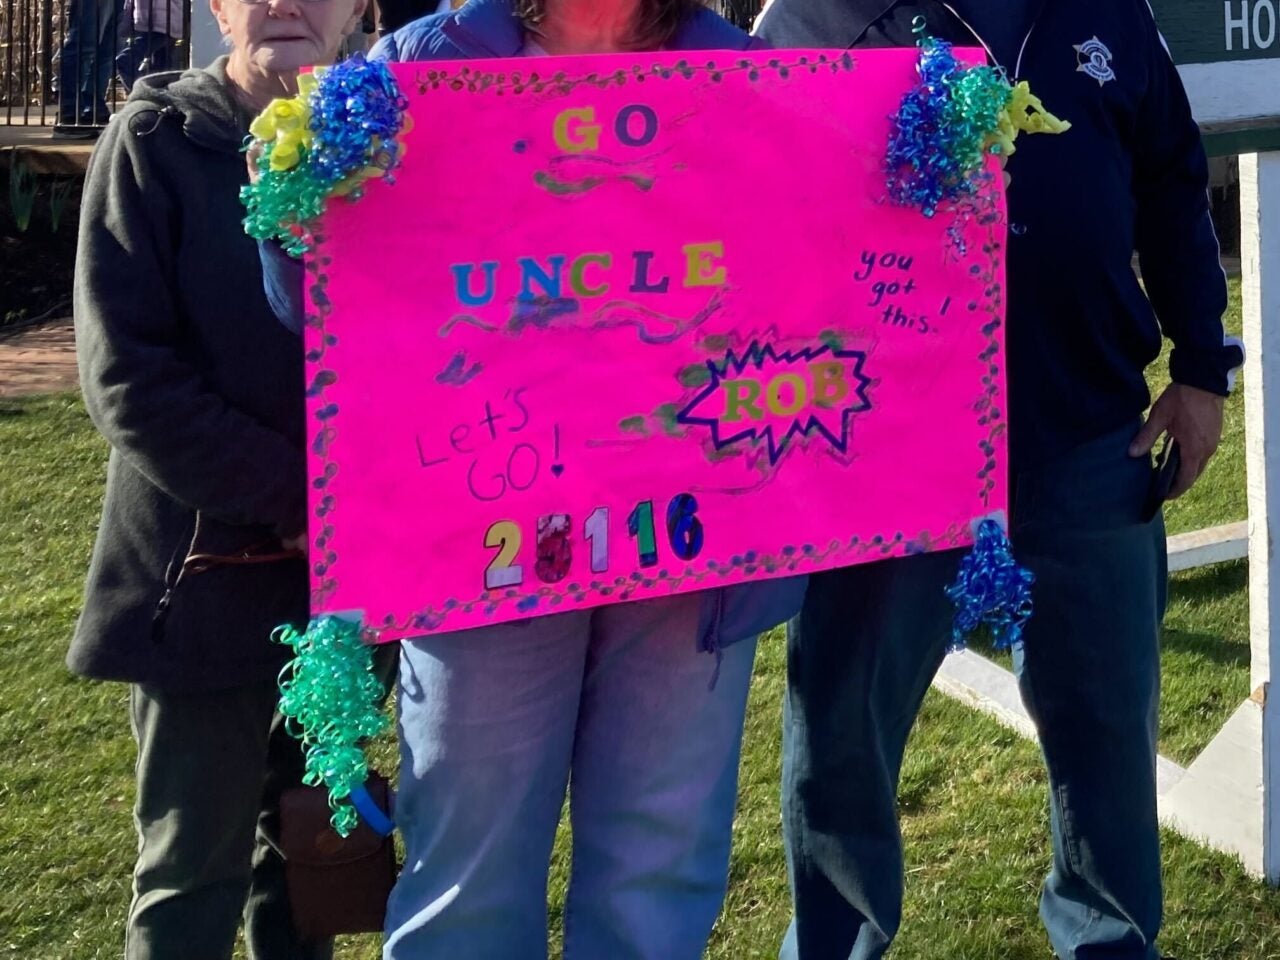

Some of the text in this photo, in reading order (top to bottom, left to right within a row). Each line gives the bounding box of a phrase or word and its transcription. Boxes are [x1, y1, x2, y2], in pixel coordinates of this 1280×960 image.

[552, 103, 659, 154] GO
[450, 240, 727, 306] UNCLE
[853, 250, 914, 281] you
[867, 279, 917, 307] got
[720, 361, 849, 423] ROB
